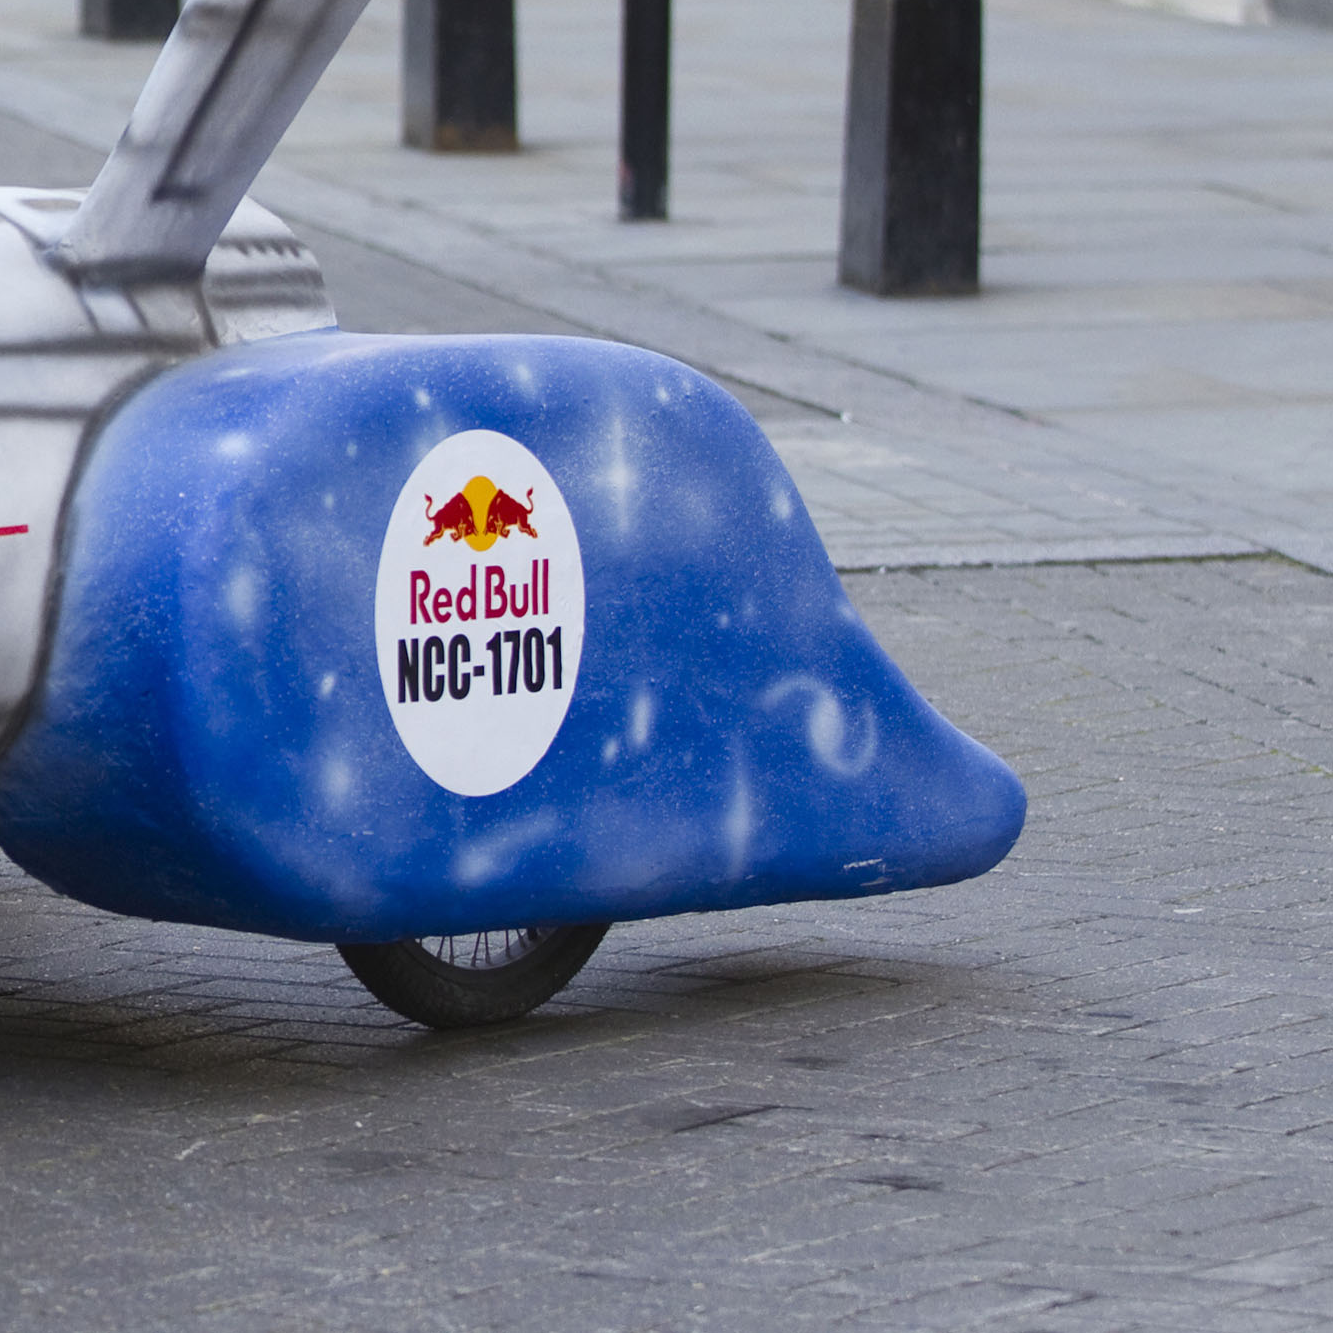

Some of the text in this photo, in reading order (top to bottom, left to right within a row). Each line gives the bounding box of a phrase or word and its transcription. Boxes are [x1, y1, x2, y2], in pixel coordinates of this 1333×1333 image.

[410, 558, 549, 625] Red Bull
[397, 625, 563, 704] NCC-1701
